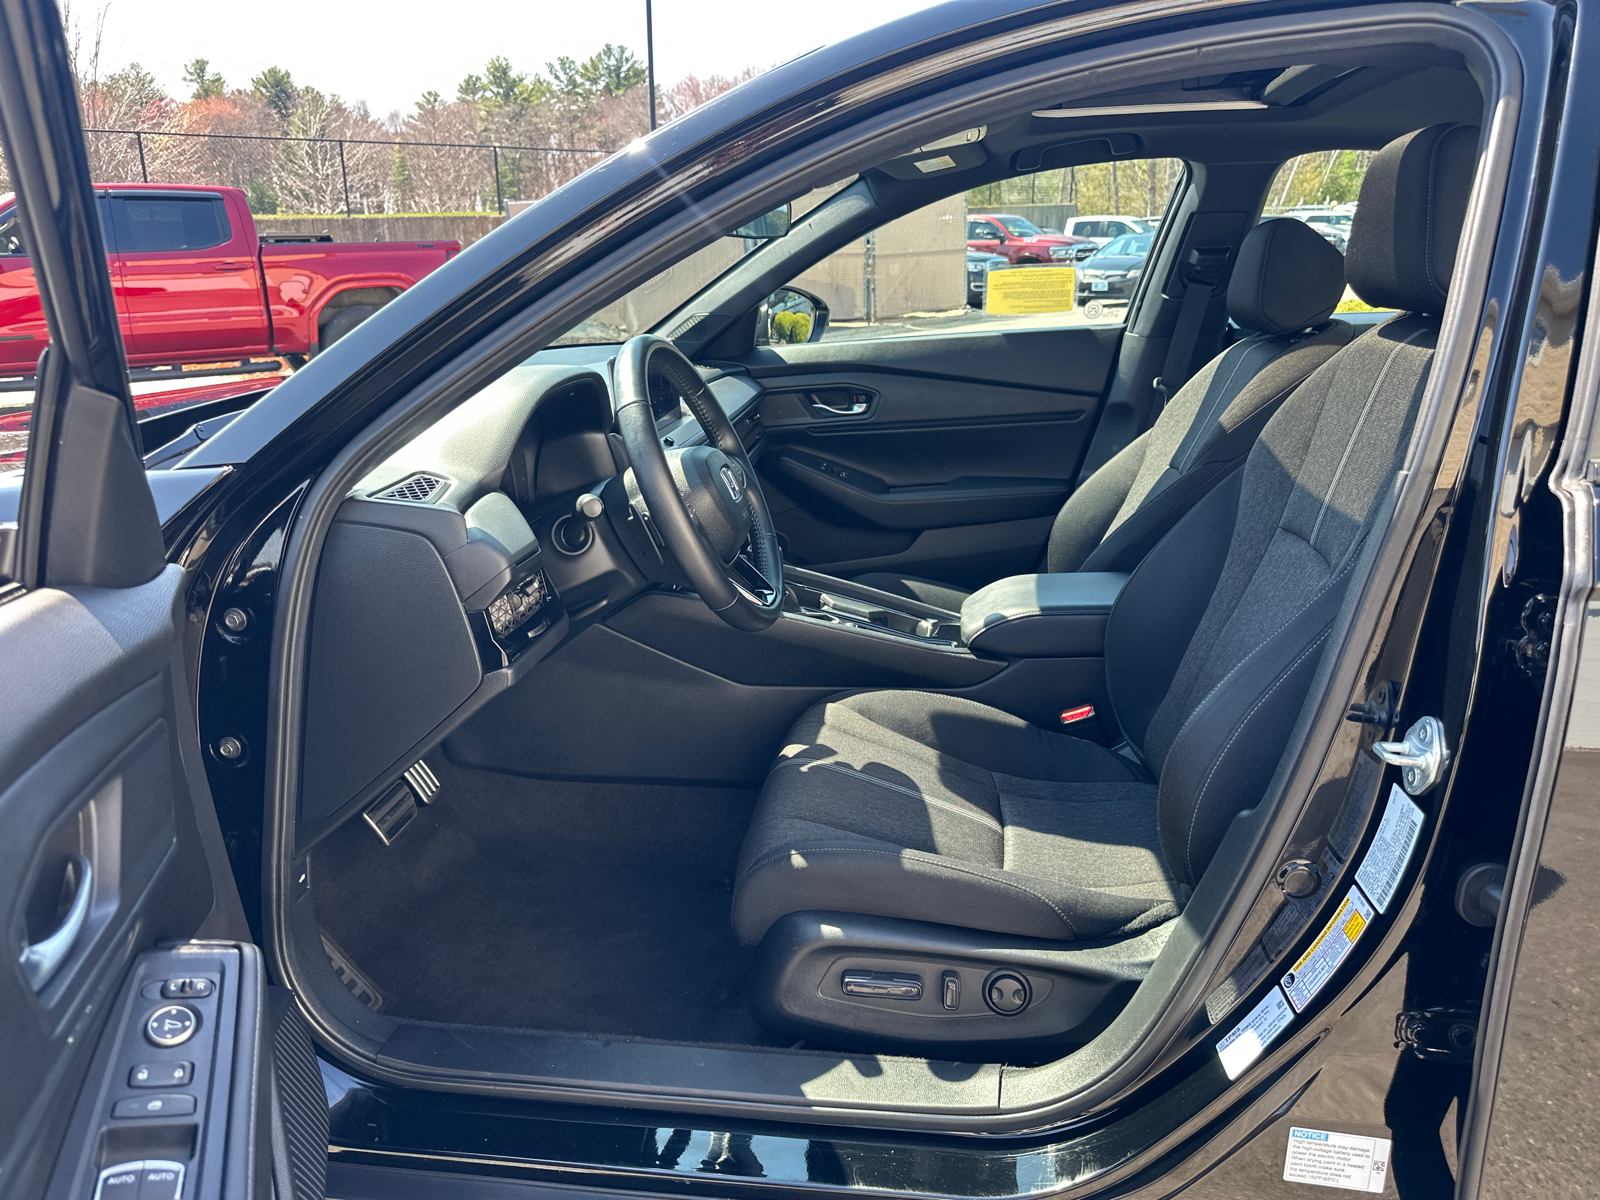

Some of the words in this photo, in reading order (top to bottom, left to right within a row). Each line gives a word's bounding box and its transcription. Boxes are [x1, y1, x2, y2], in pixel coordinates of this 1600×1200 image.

[1310, 931, 1327, 952] LOADING
[1326, 898, 1350, 931] INFORMATION
[196, 982, 206, 990] R
[1224, 1027, 1241, 1043] TPMS
[1294, 1130, 1326, 1140] NOTICE
[108, 1174, 136, 1185] AUTO
[148, 1172, 175, 1181] AUTO
